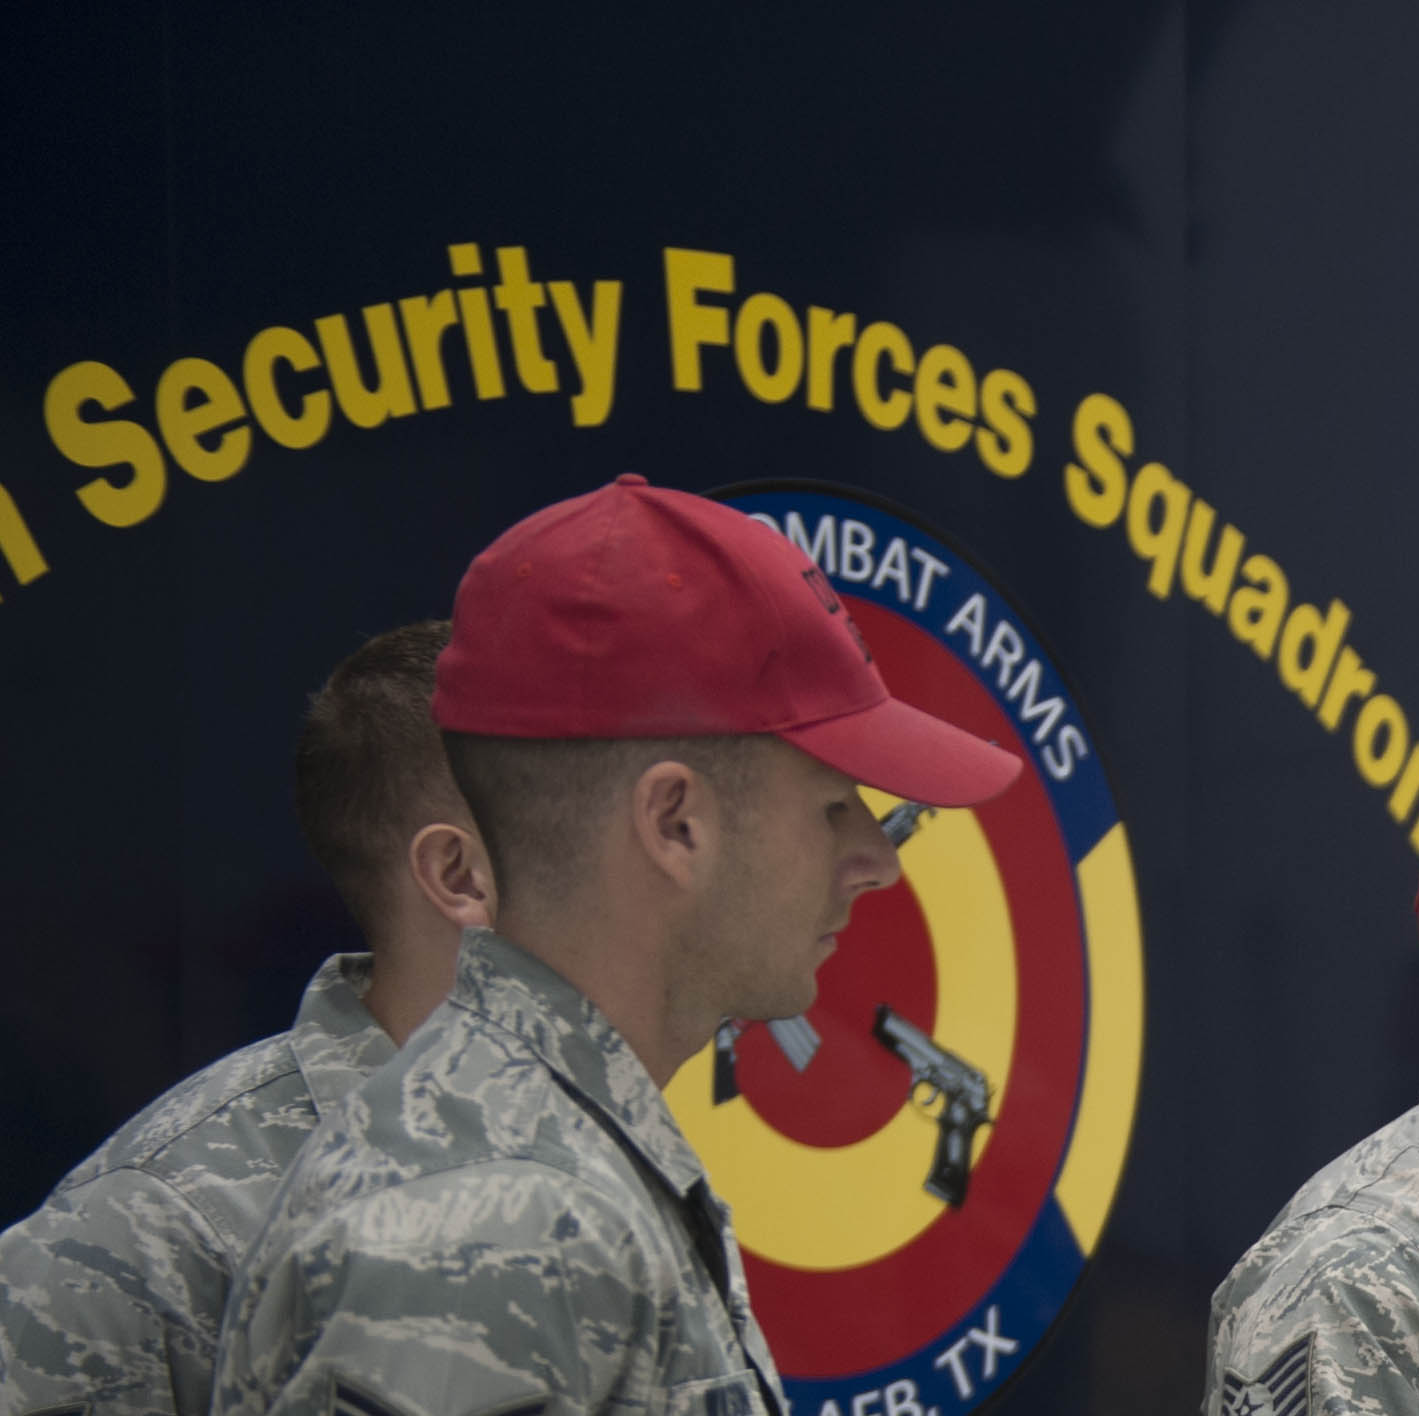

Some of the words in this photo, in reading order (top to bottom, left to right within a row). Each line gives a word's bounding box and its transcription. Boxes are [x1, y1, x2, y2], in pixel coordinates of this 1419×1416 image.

[44, 243, 622, 527] Security
[663, 247, 1037, 478] Forces
[748, 511, 950, 610] MBAT
[945, 592, 1088, 780] ARMS
[936, 1305, 1018, 1400] TX
